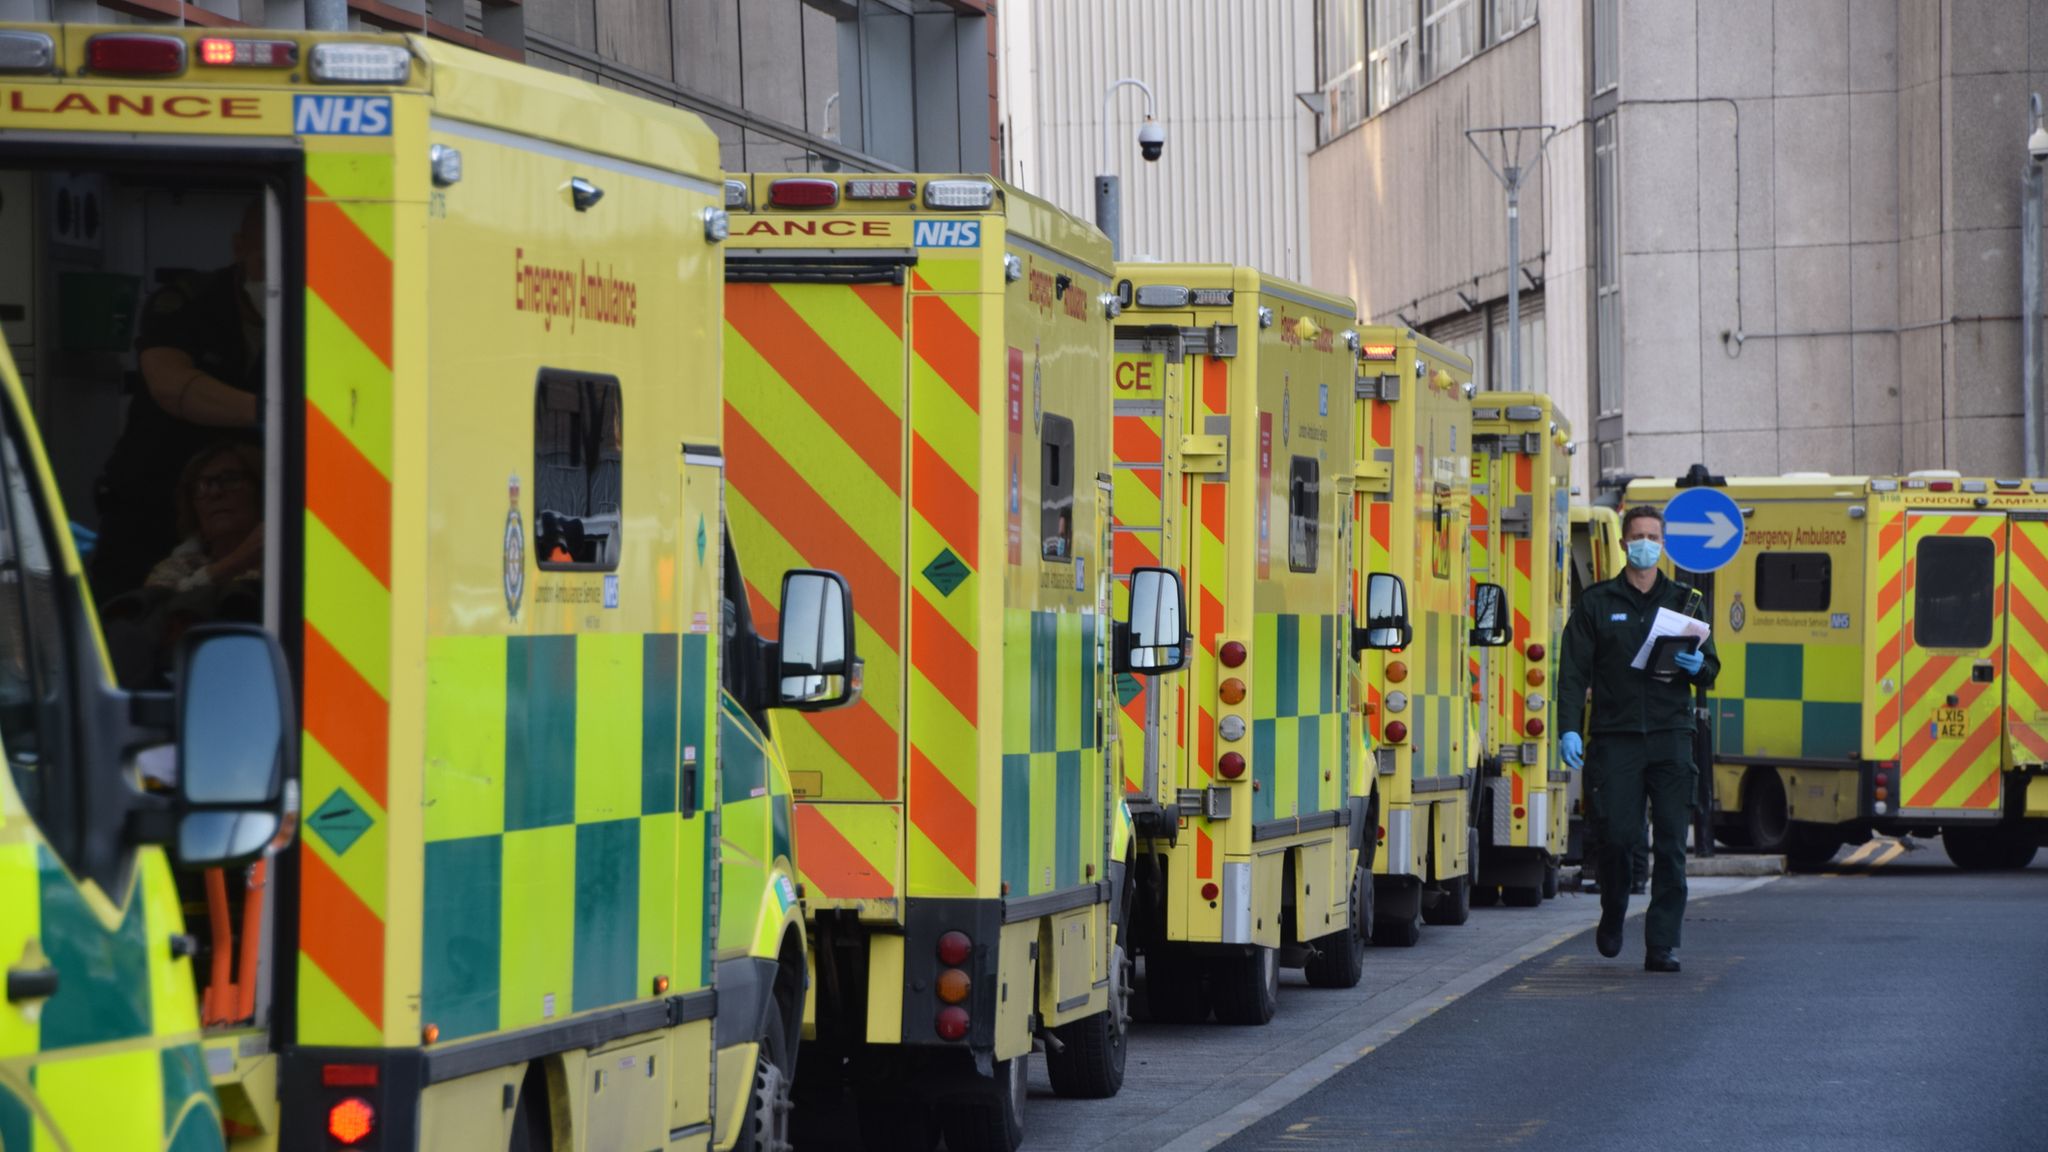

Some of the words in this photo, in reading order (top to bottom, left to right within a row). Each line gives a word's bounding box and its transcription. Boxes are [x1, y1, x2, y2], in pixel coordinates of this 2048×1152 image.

[295, 97, 390, 134] NHS
[915, 221, 978, 246] NHS
[516, 247, 577, 336] Emergency
[579, 258, 637, 329] Ambulance
[1115, 361, 1152, 390] CE
[1904, 496, 1971, 505] LONDON
[1795, 526, 1847, 545] Ambulance
[1937, 710, 1964, 722] LX15
[1942, 724, 1964, 736] AEZ
